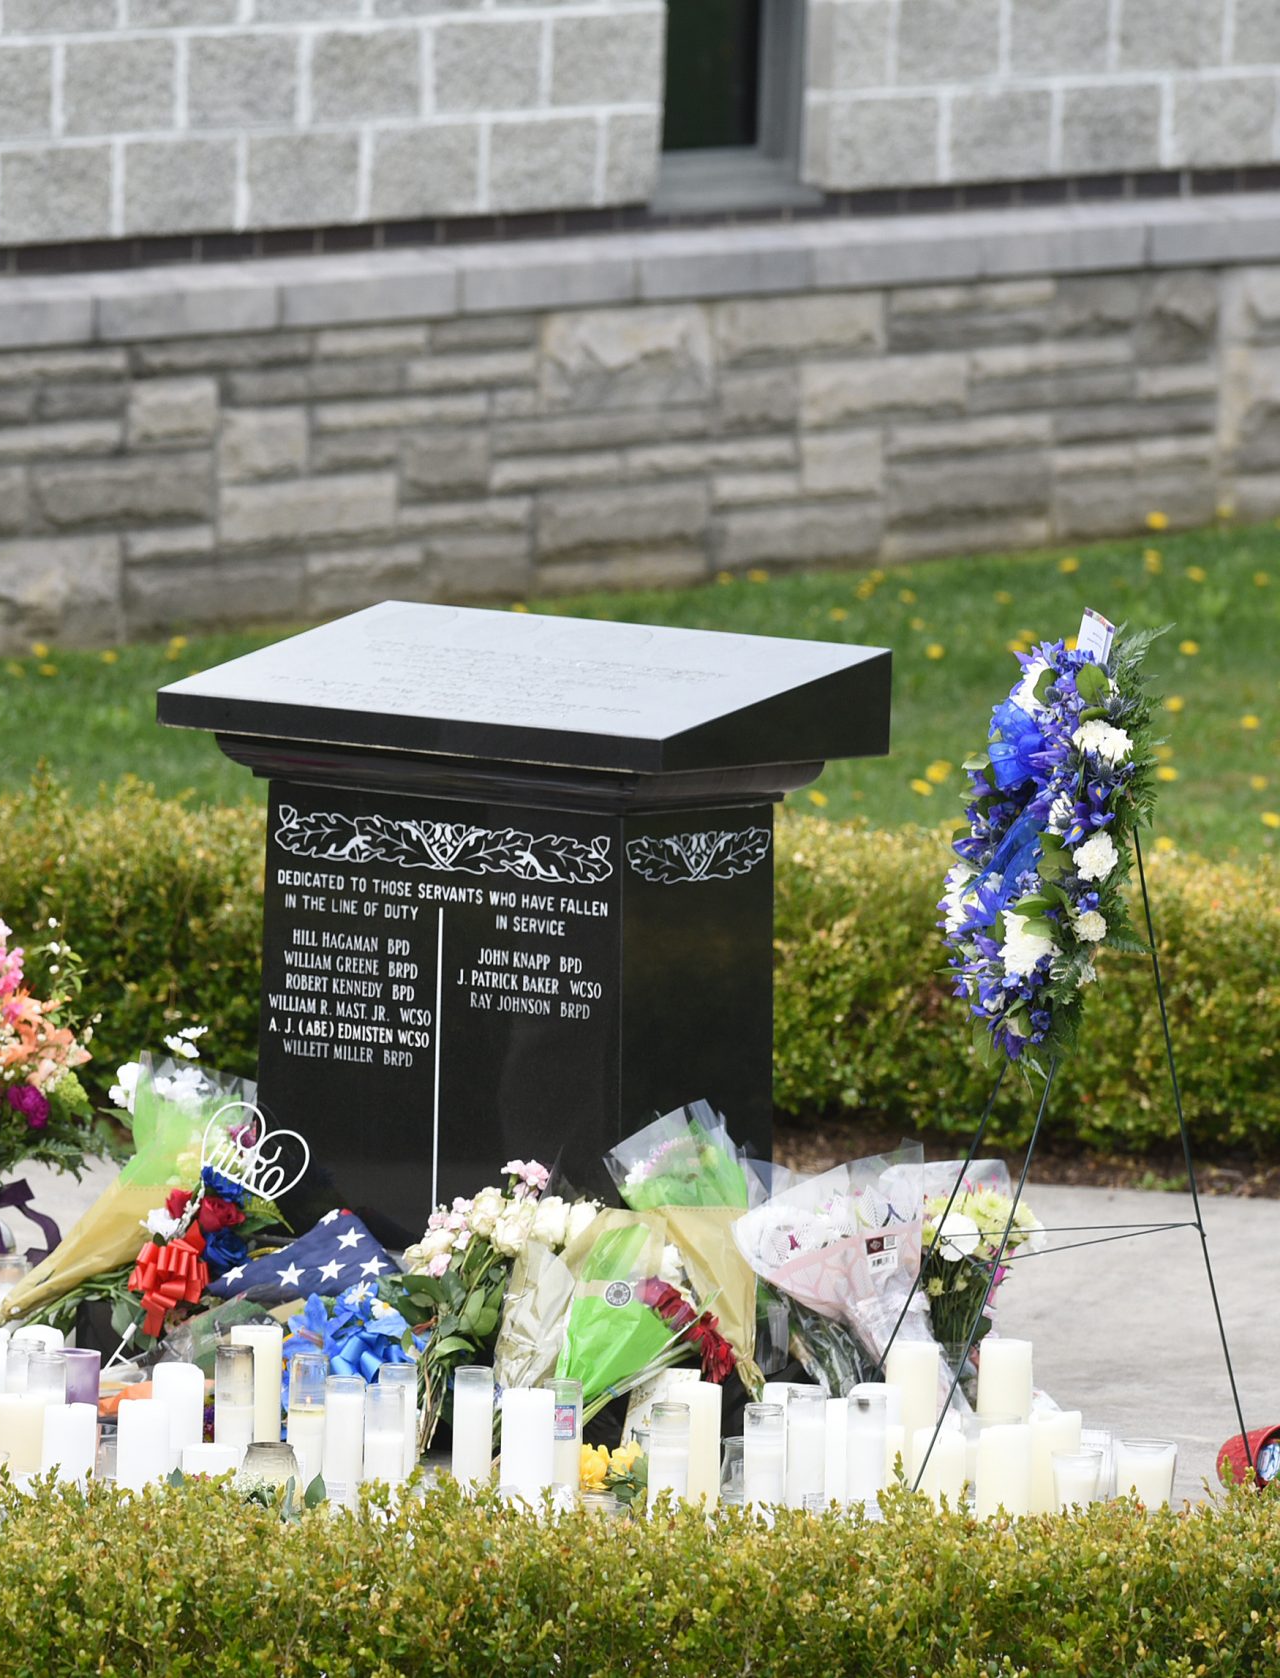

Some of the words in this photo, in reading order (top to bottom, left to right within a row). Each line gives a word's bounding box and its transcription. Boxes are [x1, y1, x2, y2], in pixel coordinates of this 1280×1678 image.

[277, 869, 345, 890] DEDICATED
[350, 877, 367, 892] TO
[372, 879, 412, 897] THOSE
[418, 883, 483, 904] SERVANTS
[489, 890, 516, 908] WHO
[522, 894, 555, 911] HAVE
[560, 898, 608, 917] FALLEN
[285, 893, 296, 908] IN
[302, 895, 326, 911] THE
[331, 898, 358, 915] LINE
[363, 901, 379, 916] OF
[384, 903, 419, 920] DUTY
[496, 915, 507, 930] IN
[513, 916, 565, 936] SERVICE
[292, 929, 318, 947] HILL
[322, 932, 378, 952] HAGAMAN
[387, 938, 410, 956] BPD
[284, 950, 332, 970] WILLIAM
[336, 956, 379, 975] GREENE
[388, 961, 418, 980] BRPD
[478, 948, 509, 966] JOHN
[513, 951, 550, 971] KNAPP
[560, 956, 582, 974] BPD
[286, 973, 329, 993] ROBERT
[332, 978, 383, 998] KENNEDY
[392, 984, 414, 1001] BPD
[457, 969, 467, 985] J.
[472, 970, 518, 990] PATRICK
[522, 975, 559, 994] BAKER
[570, 980, 601, 999] WCSO
[269, 993, 316, 1014] WILLIAM
[320, 1000, 332, 1016] R.
[371, 1005, 390, 1021] JR.
[400, 1007, 431, 1027] WCSO
[470, 992, 493, 1009] RAY
[497, 995, 550, 1015] JOHNSON
[560, 1002, 590, 1020] BRPD
[269, 1017, 280, 1032] A.
[284, 1018, 295, 1033] J.
[298, 1019, 334, 1038] (ABE)
[338, 1023, 393, 1044] EDMISTEN
[398, 1029, 429, 1048] WCSO
[283, 1039, 330, 1058] WILLETT
[333, 1044, 373, 1063] MILLER
[383, 1050, 413, 1067] BRPD
[207, 1138, 285, 1196] HERO
